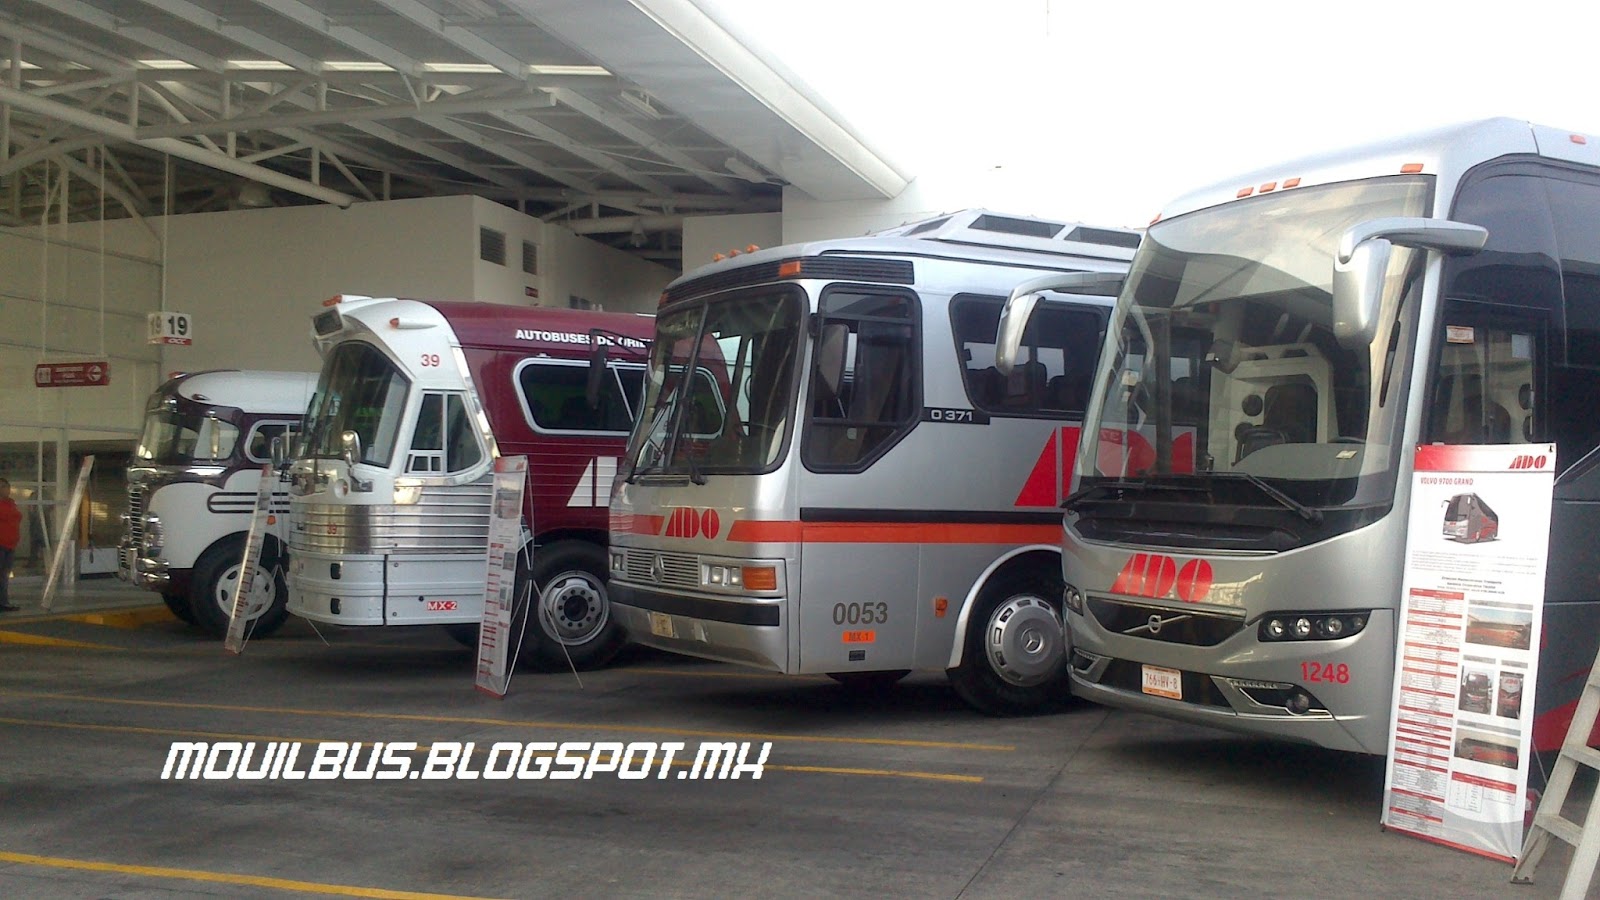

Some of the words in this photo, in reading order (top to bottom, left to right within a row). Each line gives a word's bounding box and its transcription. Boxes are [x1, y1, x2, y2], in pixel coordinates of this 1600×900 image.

[168, 316, 188, 335] 19
[515, 329, 592, 345] AUTOBUSES
[597, 336, 615, 345] DE
[421, 354, 440, 367] 39
[945, 410, 973, 421] 371
[1508, 455, 1546, 469] ADO
[1420, 477, 1437, 485] VOLVO
[1454, 478, 1474, 486] GRAND
[665, 507, 720, 539] ADO
[1110, 553, 1213, 603] ADO
[832, 602, 888, 625] 0053
[1301, 661, 1350, 684] 1248
